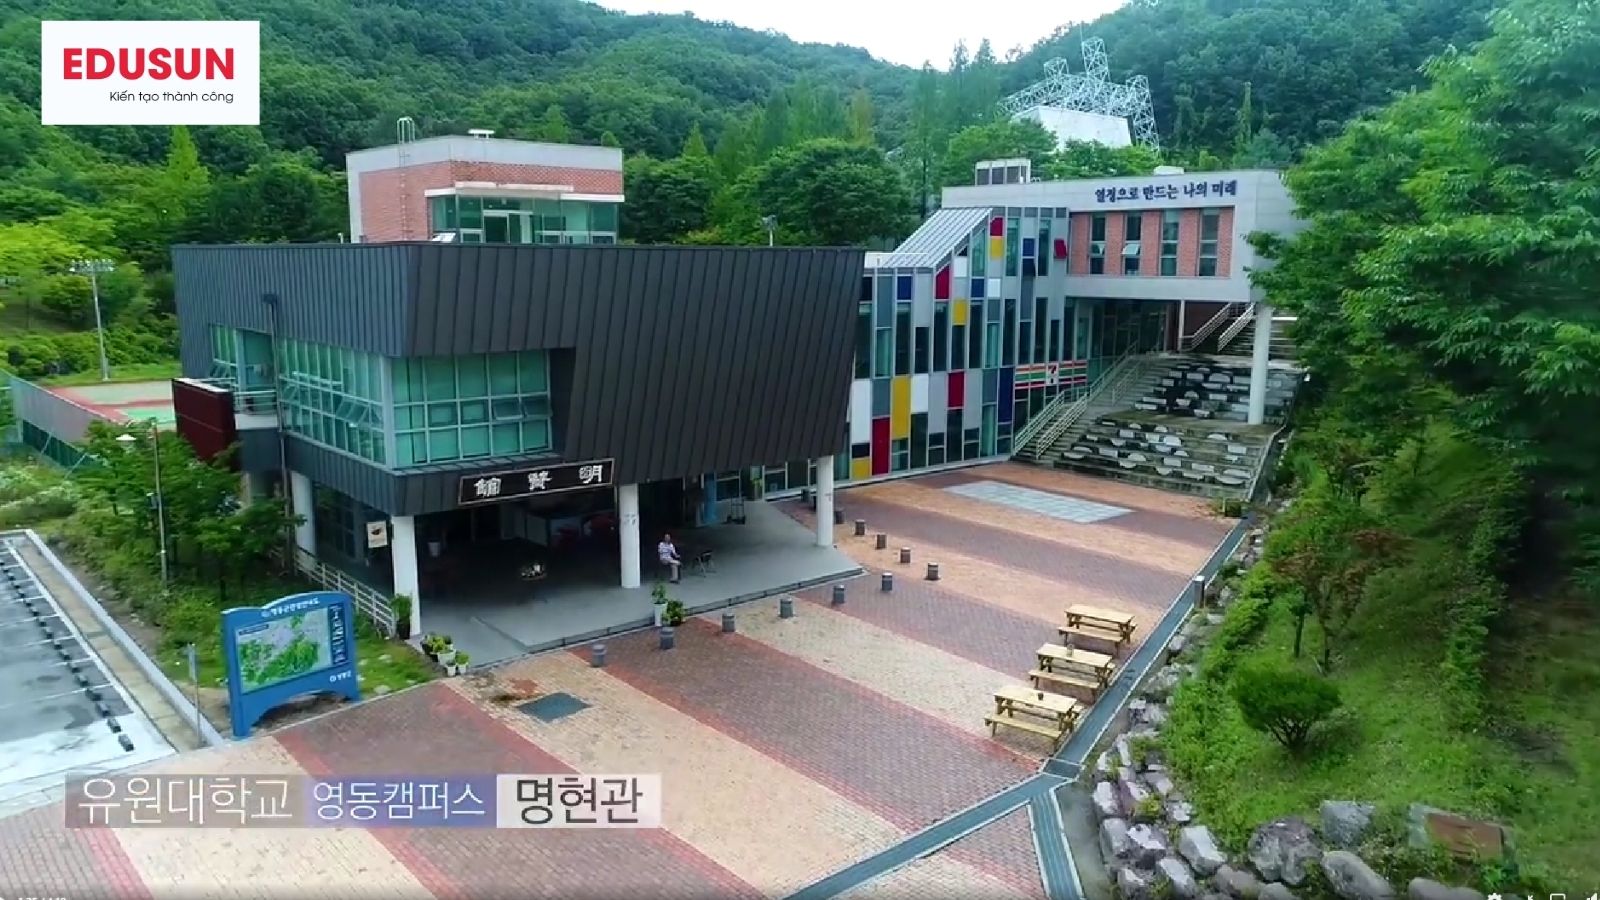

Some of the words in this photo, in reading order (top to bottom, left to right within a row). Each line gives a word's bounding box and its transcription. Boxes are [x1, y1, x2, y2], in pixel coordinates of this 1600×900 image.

[1094, 186, 1139, 203] 열정으로
[1142, 184, 1179, 201] 만드는
[1183, 181, 1207, 198] 나의
[1211, 180, 1238, 197] 미래
